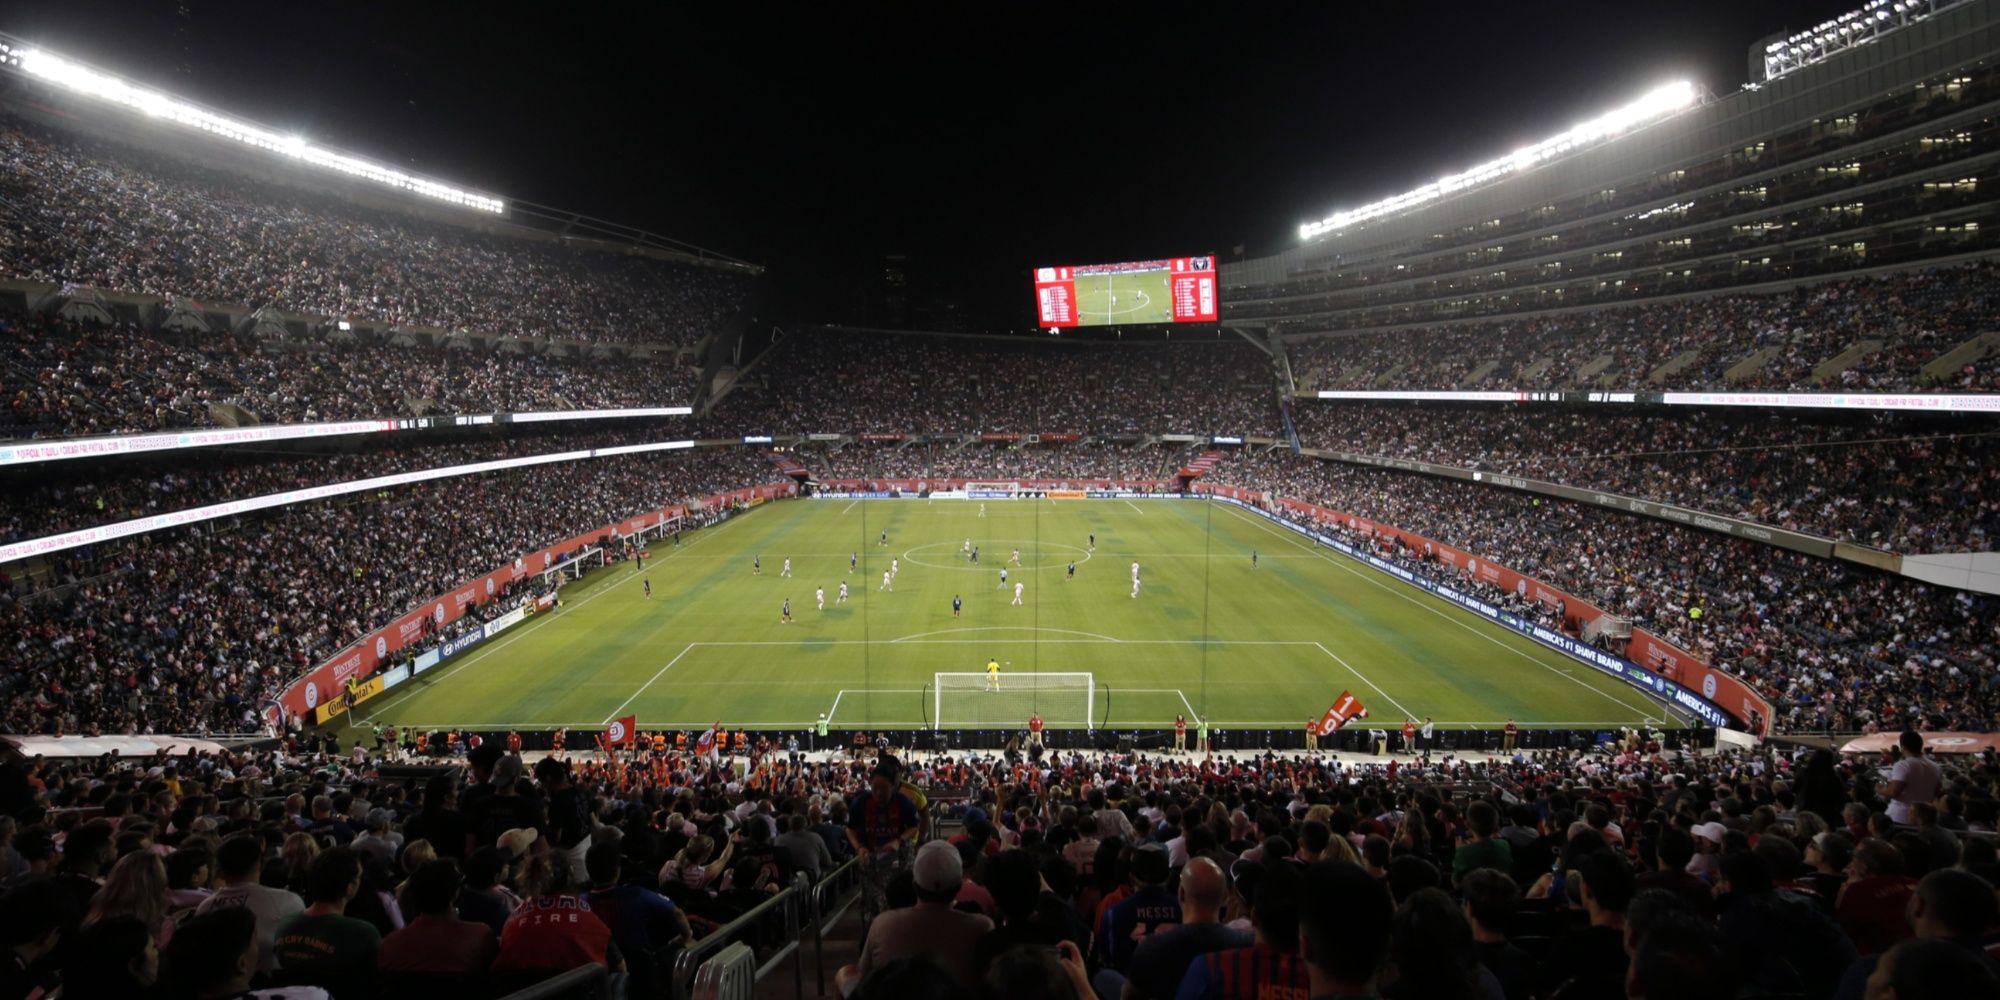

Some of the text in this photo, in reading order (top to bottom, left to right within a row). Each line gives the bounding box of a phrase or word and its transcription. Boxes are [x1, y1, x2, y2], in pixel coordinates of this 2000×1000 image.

[454, 629, 482, 650] HYUNDAI
[1533, 627, 1565, 648] AMERICA'S
[1574, 644, 1597, 662] SHAVE
[1597, 653, 1623, 672] BRAND
[1675, 689, 1712, 719] AMERICA'S
[519, 912, 578, 929] FIRE
[1136, 905, 1175, 920] MESSI
